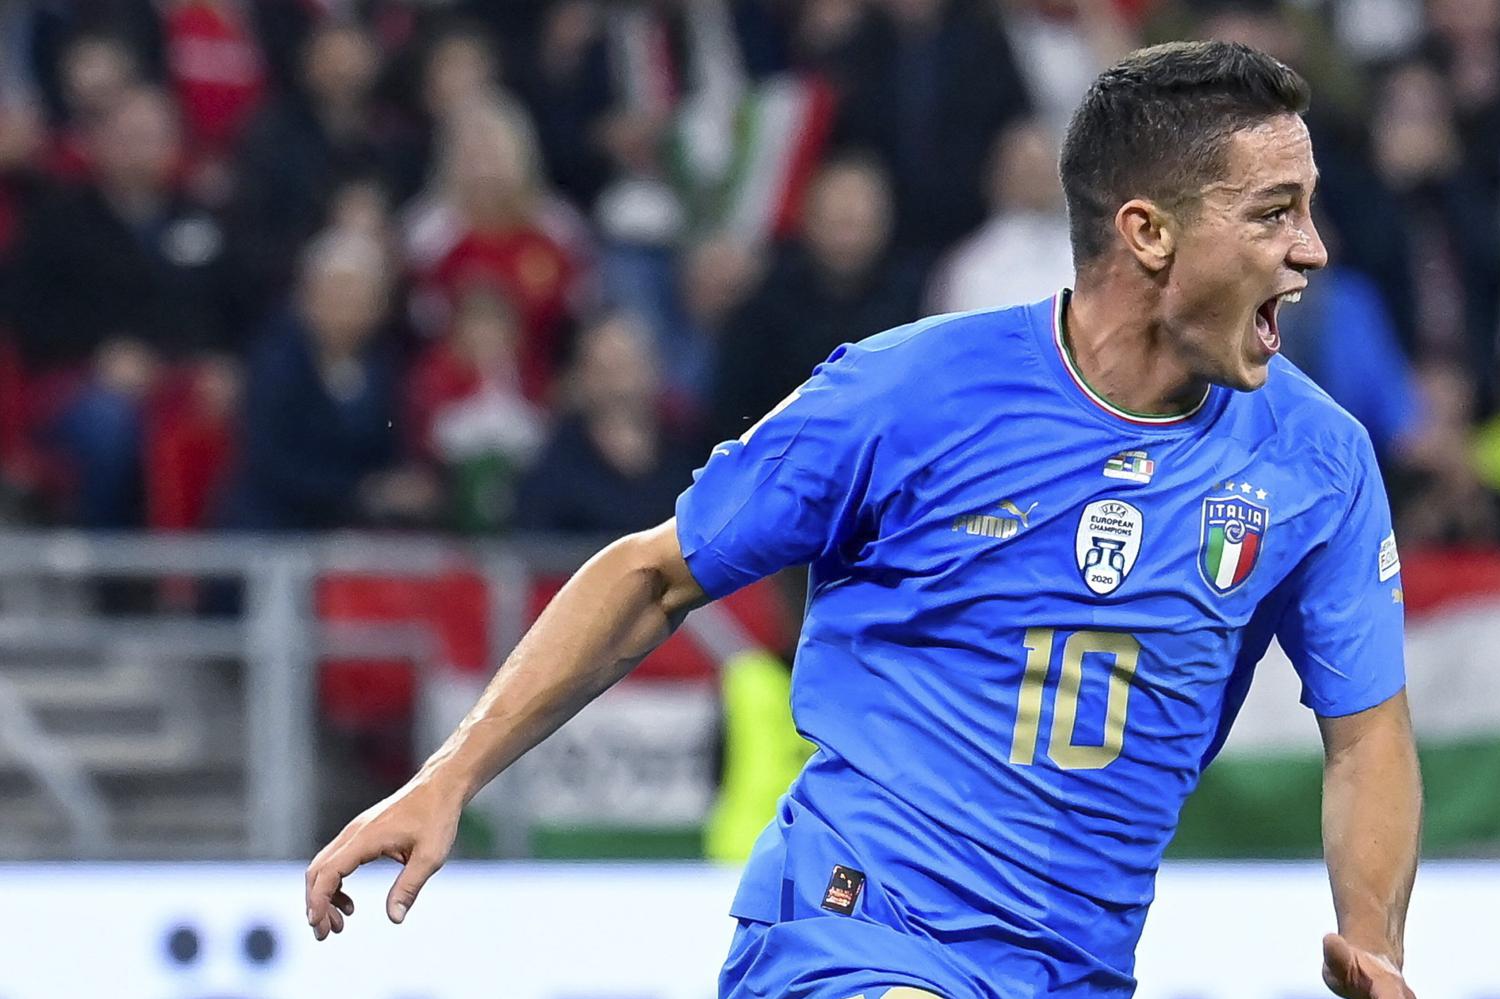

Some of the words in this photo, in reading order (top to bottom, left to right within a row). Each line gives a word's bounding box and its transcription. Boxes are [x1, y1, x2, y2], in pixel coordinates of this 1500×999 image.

[1101, 503, 1128, 518] UEFA
[1209, 504, 1262, 526] ITALIA
[1090, 515, 1134, 529] EUROPEAN
[1089, 523, 1133, 536] CHAMPIONS
[1091, 574, 1113, 585] 2020
[1009, 627, 1141, 770] 10
